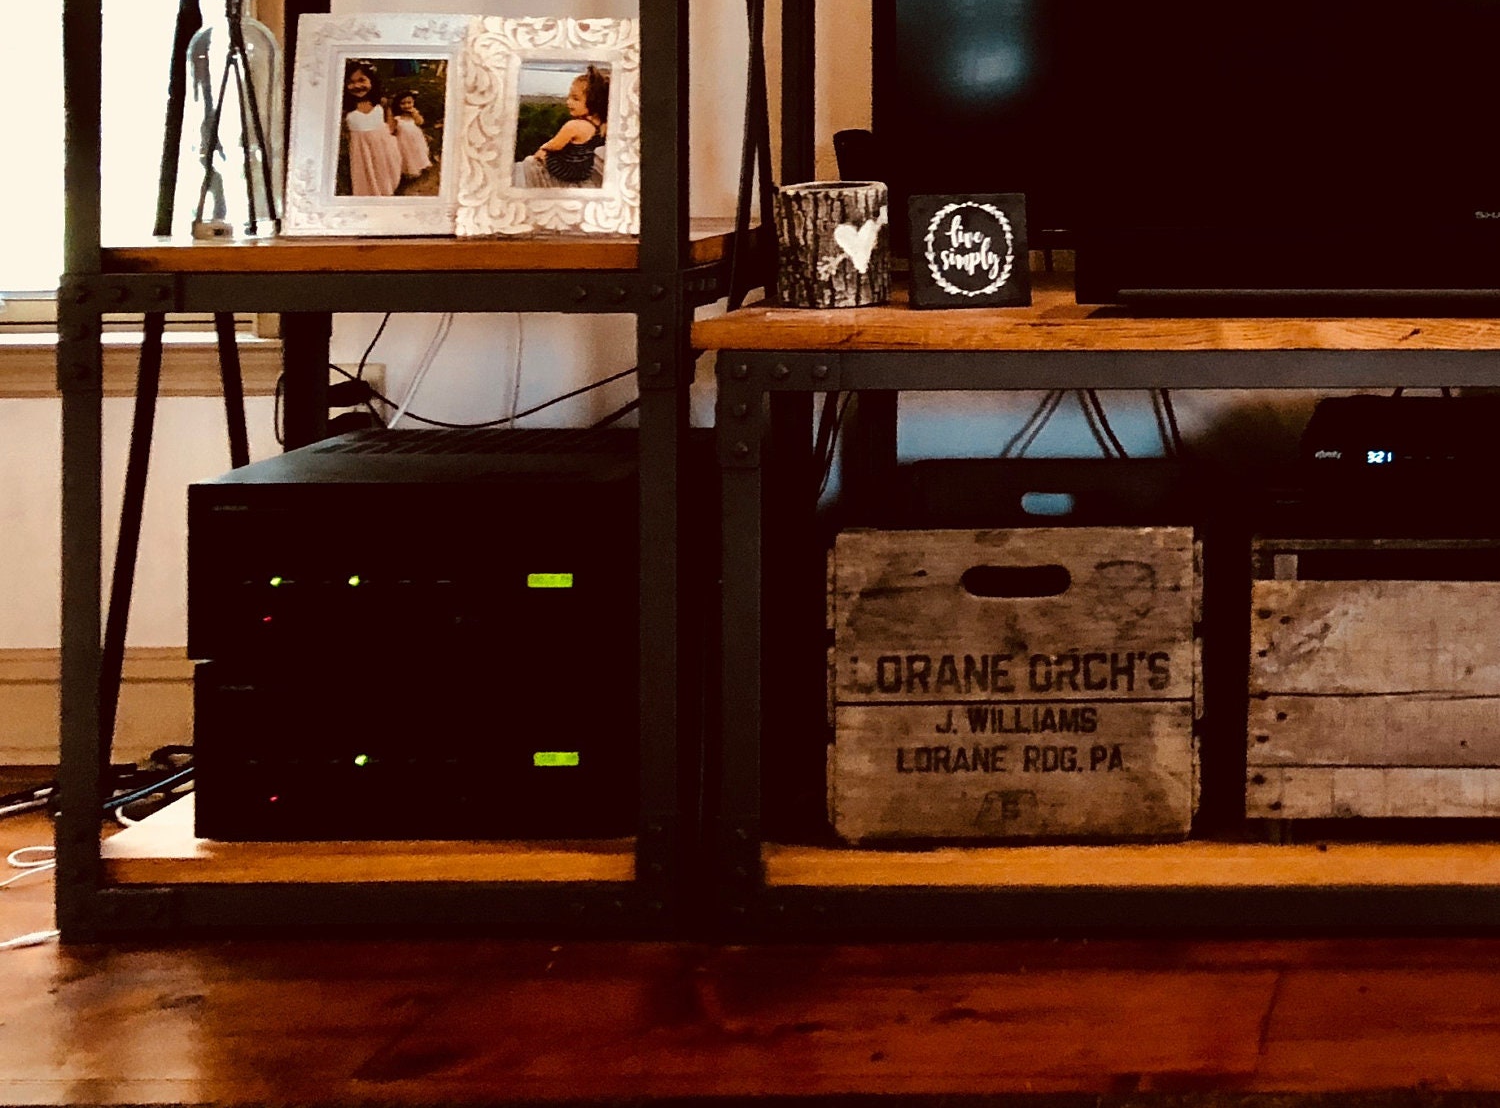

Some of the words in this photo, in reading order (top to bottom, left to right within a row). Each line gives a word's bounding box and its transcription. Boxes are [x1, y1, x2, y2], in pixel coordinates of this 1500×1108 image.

[945, 214, 985, 249] live
[940, 237, 1001, 281] simply
[935, 706, 958, 735] J.
[966, 706, 1099, 735] WILLIAMS
[896, 744, 1008, 773] LORANE
